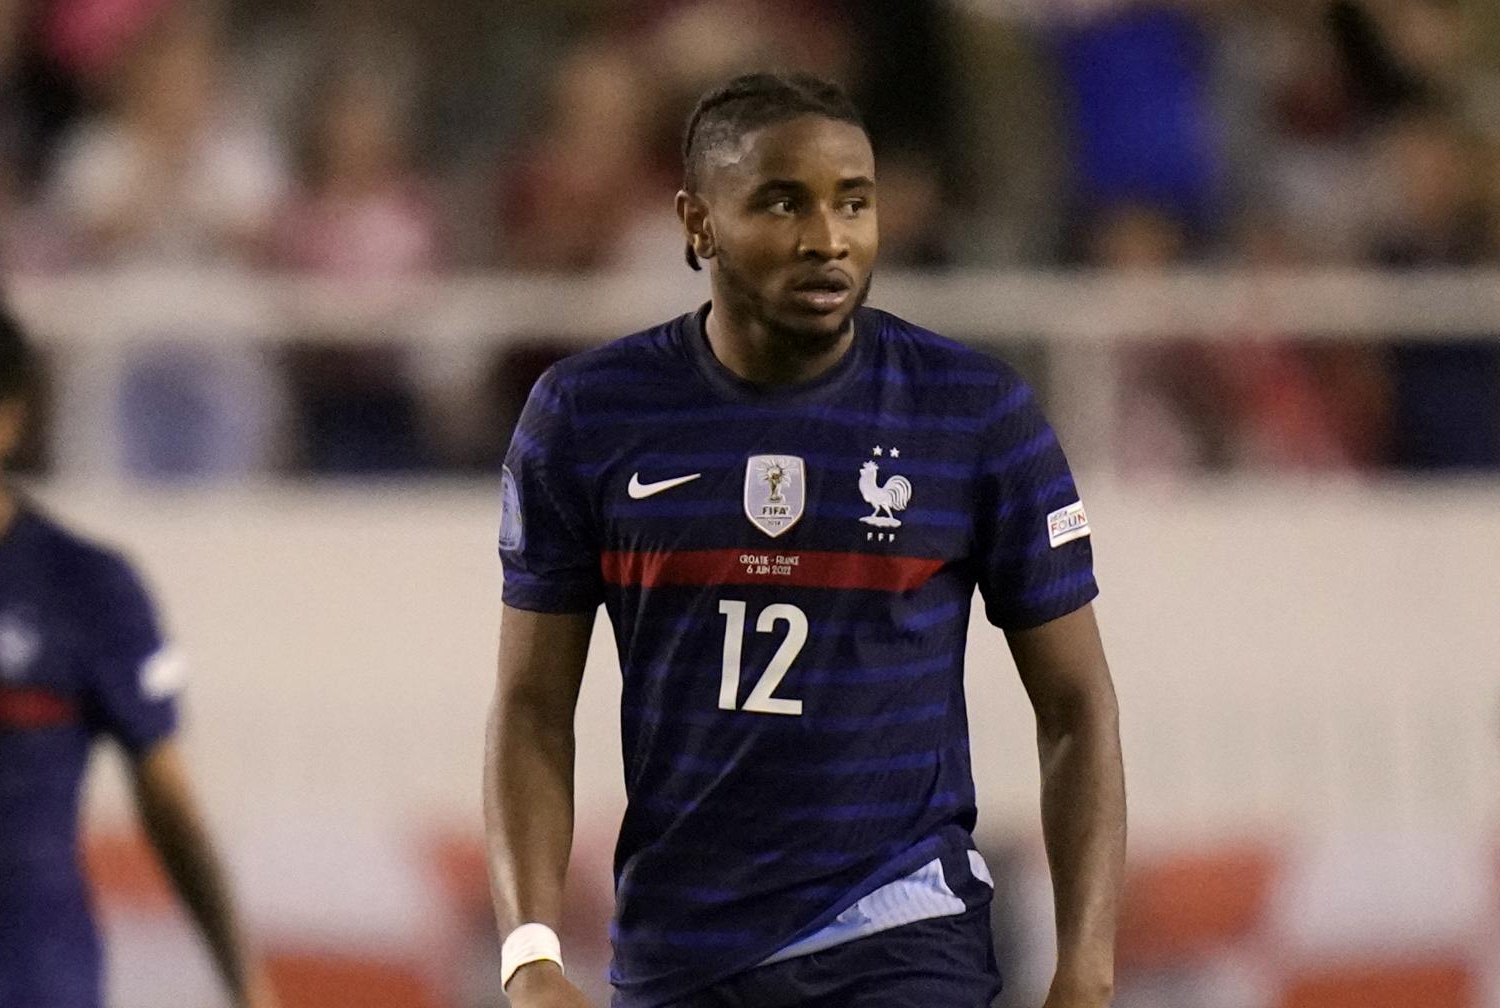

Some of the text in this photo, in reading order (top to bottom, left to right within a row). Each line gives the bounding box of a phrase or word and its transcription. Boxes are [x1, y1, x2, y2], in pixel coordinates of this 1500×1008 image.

[762, 506, 788, 515] FIFA
[739, 554, 768, 565] CROATIE
[746, 565, 753, 574] 6
[717, 600, 809, 716] 12
